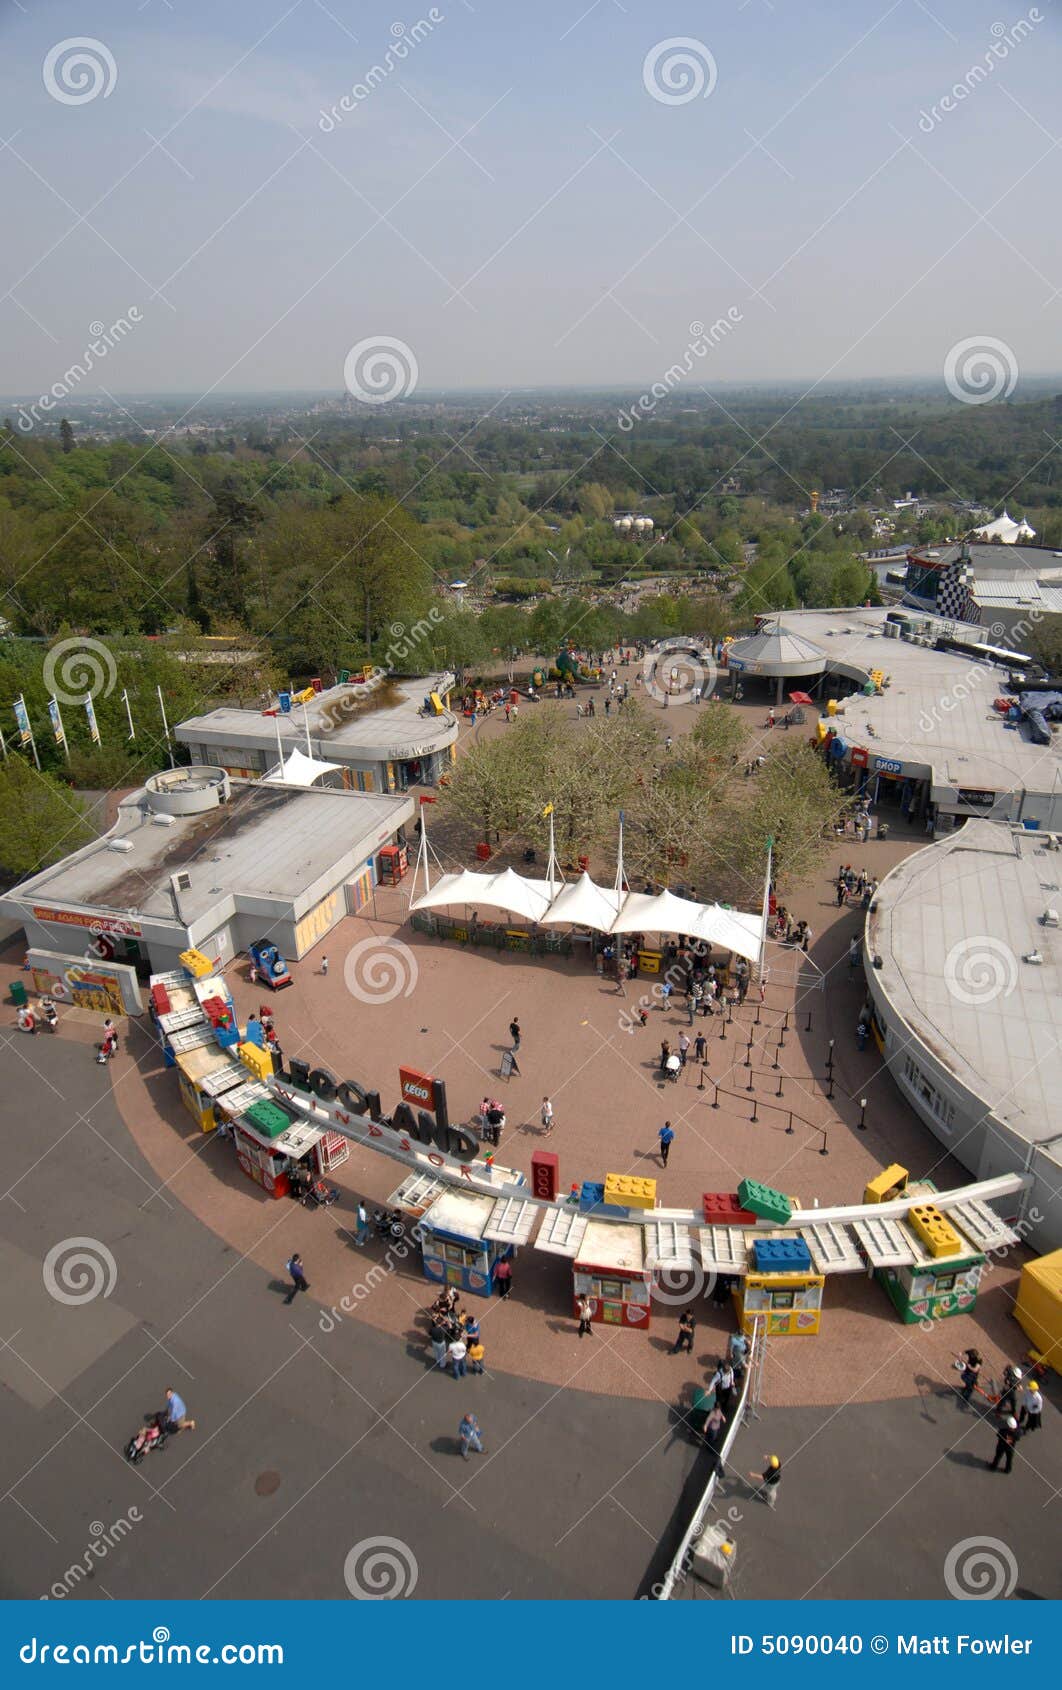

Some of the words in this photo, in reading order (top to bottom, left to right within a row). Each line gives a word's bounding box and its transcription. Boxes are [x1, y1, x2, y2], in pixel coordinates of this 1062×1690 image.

[875, 759, 901, 772] SHOP
[271, 1049, 479, 1163] LEGOLAND
[404, 1082, 430, 1100] LEGO
[275, 1083, 472, 1182] WINDSOR
